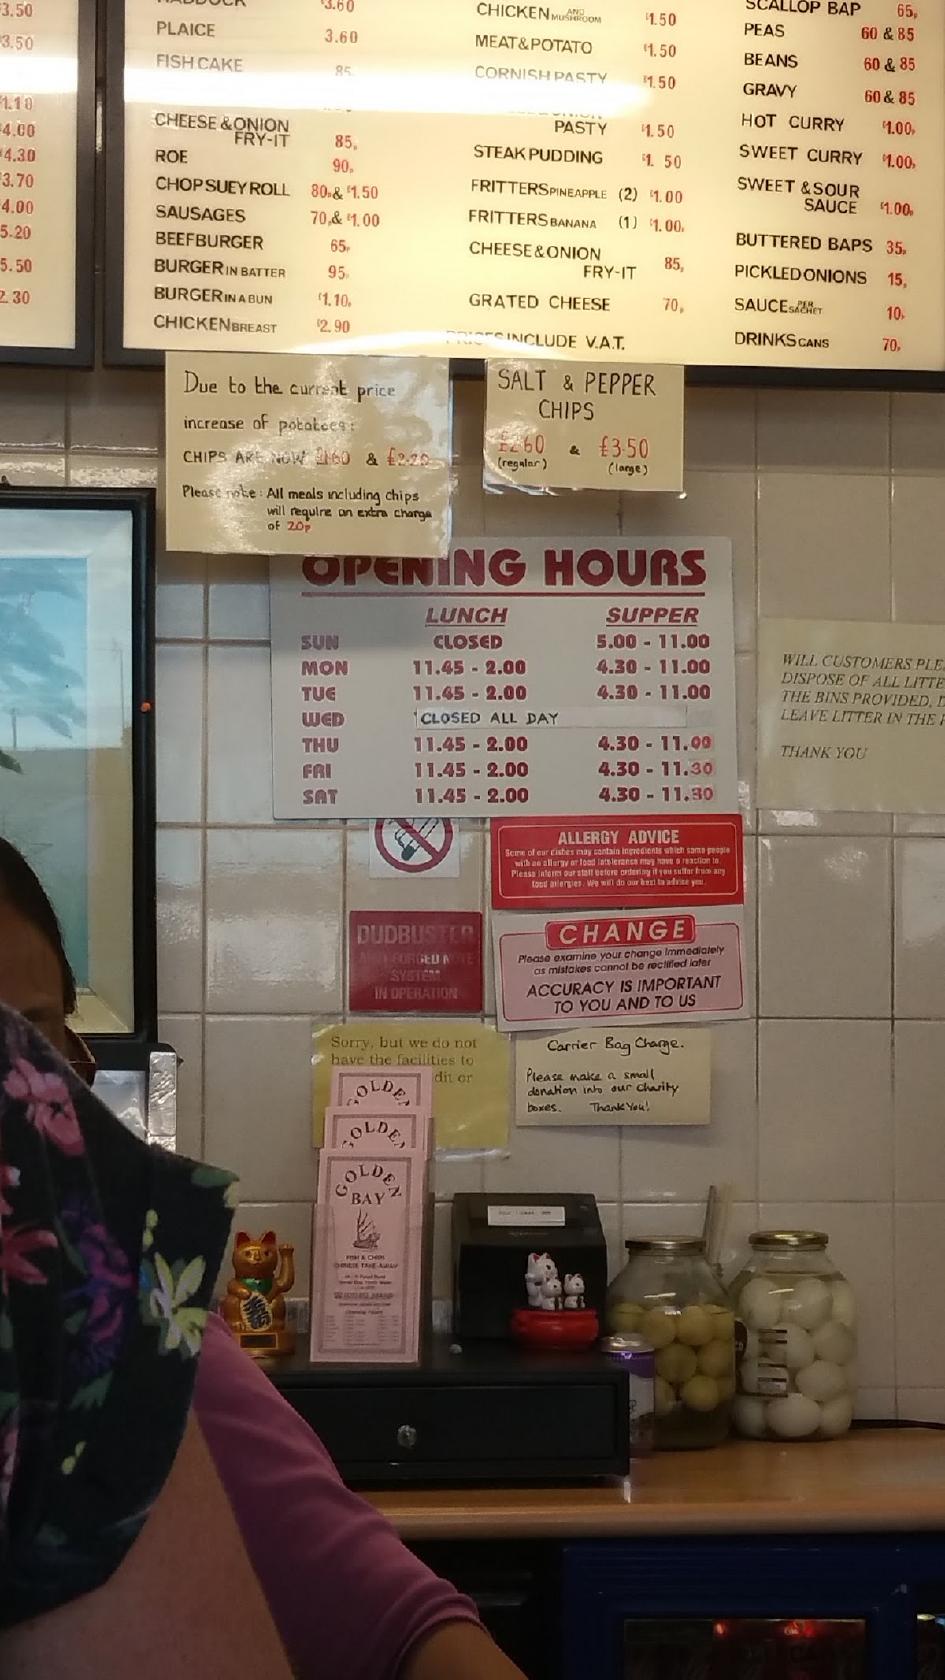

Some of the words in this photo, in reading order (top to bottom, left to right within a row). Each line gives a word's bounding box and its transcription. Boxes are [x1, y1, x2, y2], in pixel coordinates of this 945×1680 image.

[477, 2, 550, 20] CHICKEN
[746, 0, 820, 13] SCALLOP
[828, 1, 861, 16] BAP
[551, 14, 602, 23] MUSHROOM
[157, 20, 216, 37] PLAICE
[325, 29, 358, 43] 3.60
[744, 23, 785, 37] PEAS
[861, 27, 878, 40] 60
[883, 27, 893, 40] &
[897, 27, 914, 42] 85
[156, 54, 194, 70] FISH
[198, 56, 243, 72] CAKE
[744, 53, 798, 68] BEANS
[743, 83, 797, 98] GRAVY
[554, 120, 607, 135] PASTY
[155, 150, 188, 163] ROE
[474, 144, 526, 160] STEAK
[529, 148, 603, 164] PUDDING
[739, 144, 798, 160] SWEET
[807, 149, 863, 165] CURRY
[156, 176, 203, 192] CHOP
[206, 179, 247, 195] SUEY
[250, 182, 290, 196] ROLL
[471, 179, 548, 196] FRITTERS
[549, 187, 607, 199] PINEAPPLE
[619, 187, 638, 202] (2)
[156, 204, 246, 223] SAUSAGES
[804, 198, 857, 214] SAUCE
[156, 232, 263, 250] BEEFBURGER
[736, 232, 822, 250] BUTTERED
[828, 238, 873, 252] BAPS
[154, 259, 224, 275] BURGER
[226, 266, 237, 275] IN
[241, 267, 286, 278] BATTER
[584, 265, 637, 280] FRY-IT
[735, 265, 801, 281] PICKLED
[803, 268, 867, 285] ONIONS
[469, 293, 540, 310] GRATED
[549, 295, 610, 312] CHEESE
[734, 298, 788, 313] SAUCE
[154, 315, 231, 331] CHICKEN
[232, 323, 277, 333] BREAST
[735, 332, 796, 347] DRINKS
[798, 338, 829, 348] CANS
[184, 370, 217, 394] Due
[229, 376, 245, 394] to
[255, 376, 283, 395] the
[290, 380, 349, 396] current
[358, 385, 395, 402] price
[498, 369, 546, 391] SALT
[563, 375, 574, 391] &
[585, 372, 656, 396] PEPPER
[539, 399, 594, 420] CHIPS
[184, 417, 244, 429] increase
[253, 414, 269, 430] of
[267, 488, 283, 499] All
[288, 488, 323, 499] meals
[328, 488, 381, 505] including
[385, 488, 419, 504] chips
[267, 507, 285, 516] will
[291, 507, 331, 521] require
[339, 509, 352, 517] an
[358, 507, 387, 518] extra
[394, 508, 432, 521] charge
[268, 522, 280, 530] of
[287, 521, 311, 532] 20p
[302, 549, 527, 586] OPENING
[544, 549, 707, 586] HOURS
[426, 608, 508, 623] LUNCH
[606, 608, 699, 623] SUPPER
[302, 635, 339, 650] SUN
[434, 634, 503, 649] CLOSED
[597, 634, 637, 649] 5.00
[659, 634, 710, 649] 11.00
[302, 661, 348, 675] MON
[783, 653, 818, 667] WILL
[822, 655, 912, 669] CUSTOMERS
[916, 658, 945, 671] PLE
[781, 672, 845, 686] DISPOSE
[849, 674, 870, 687] OF
[873, 676, 900, 688] ALL
[302, 687, 336, 701] TUE
[782, 690, 811, 703] THE
[815, 691, 849, 704] BINS
[302, 712, 344, 727] WED
[421, 712, 480, 725] CLOSED
[490, 712, 517, 724] ALL
[526, 712, 559, 724] DAY
[781, 709, 828, 722] LEAVE
[832, 710, 882, 724] LITTER
[887, 712, 902, 724] IN
[907, 713, 936, 726] THE
[302, 738, 339, 752] THU
[781, 745, 831, 758] THANK
[836, 747, 868, 759] YOU
[302, 764, 331, 778] FRI
[303, 789, 338, 804] SAT
[558, 830, 619, 845] ALLERGY
[629, 830, 679, 844] ADVICE
[559, 920, 685, 944] CHANGE
[518, 954, 551, 964] Please
[554, 952, 597, 962] examine
[600, 951, 622, 961] your
[624, 949, 662, 960] change
[549, 964, 592, 974] mistakes
[594, 962, 628, 973] cannot
[632, 961, 644, 971] be
[690, 958, 711, 967] later
[526, 981, 614, 997] ACCURACY
[620, 980, 632, 992] IS
[638, 976, 721, 992] IMPORTANT
[554, 1001, 573, 1014] TO
[579, 999, 611, 1012] YOU
[616, 996, 650, 1011] AND
[655, 995, 673, 1008] TO
[679, 994, 696, 1006] US
[331, 1037, 374, 1051] Sorry,
[380, 1037, 402, 1048] but
[408, 1040, 428, 1048] we
[433, 1037, 449, 1048] do
[456, 1038, 477, 1048] not
[548, 1039, 599, 1051] Carrier
[605, 1037, 631, 1056] Bag
[636, 1037, 684, 1055] Charge.
[331, 1054, 364, 1065] have
[370, 1054, 392, 1065] the
[397, 1053, 454, 1065] facilities
[461, 1056, 474, 1065] to
[526, 1068, 563, 1083] Please
[570, 1072, 601, 1082] make
[608, 1072, 615, 1080] a
[624, 1068, 654, 1080] small
[528, 1085, 577, 1097] donation
[584, 1085, 602, 1094] into
[611, 1084, 631, 1093] our
[637, 1081, 679, 1097] charity
[335, 1163, 402, 1198] GOLDEN
[352, 1193, 386, 1205] BAY
